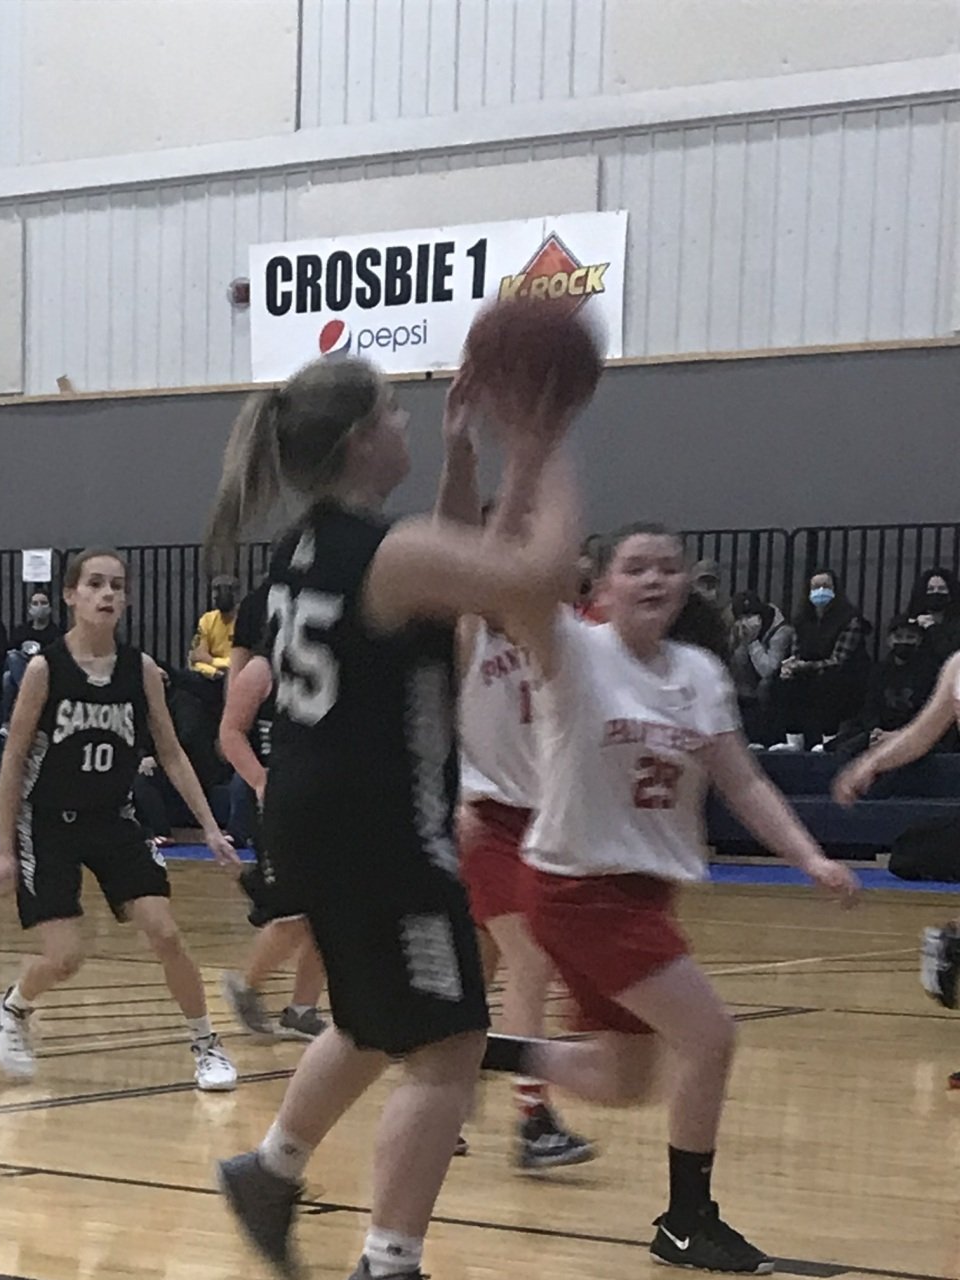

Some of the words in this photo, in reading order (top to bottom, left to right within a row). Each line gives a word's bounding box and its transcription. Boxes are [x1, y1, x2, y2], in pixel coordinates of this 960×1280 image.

[265, 240, 456, 317] CROSBIE
[466, 237, 488, 300] 1
[356, 319, 428, 352] pepsi
[52, 698, 135, 748] SAXONS
[80, 742, 115, 773] 10
